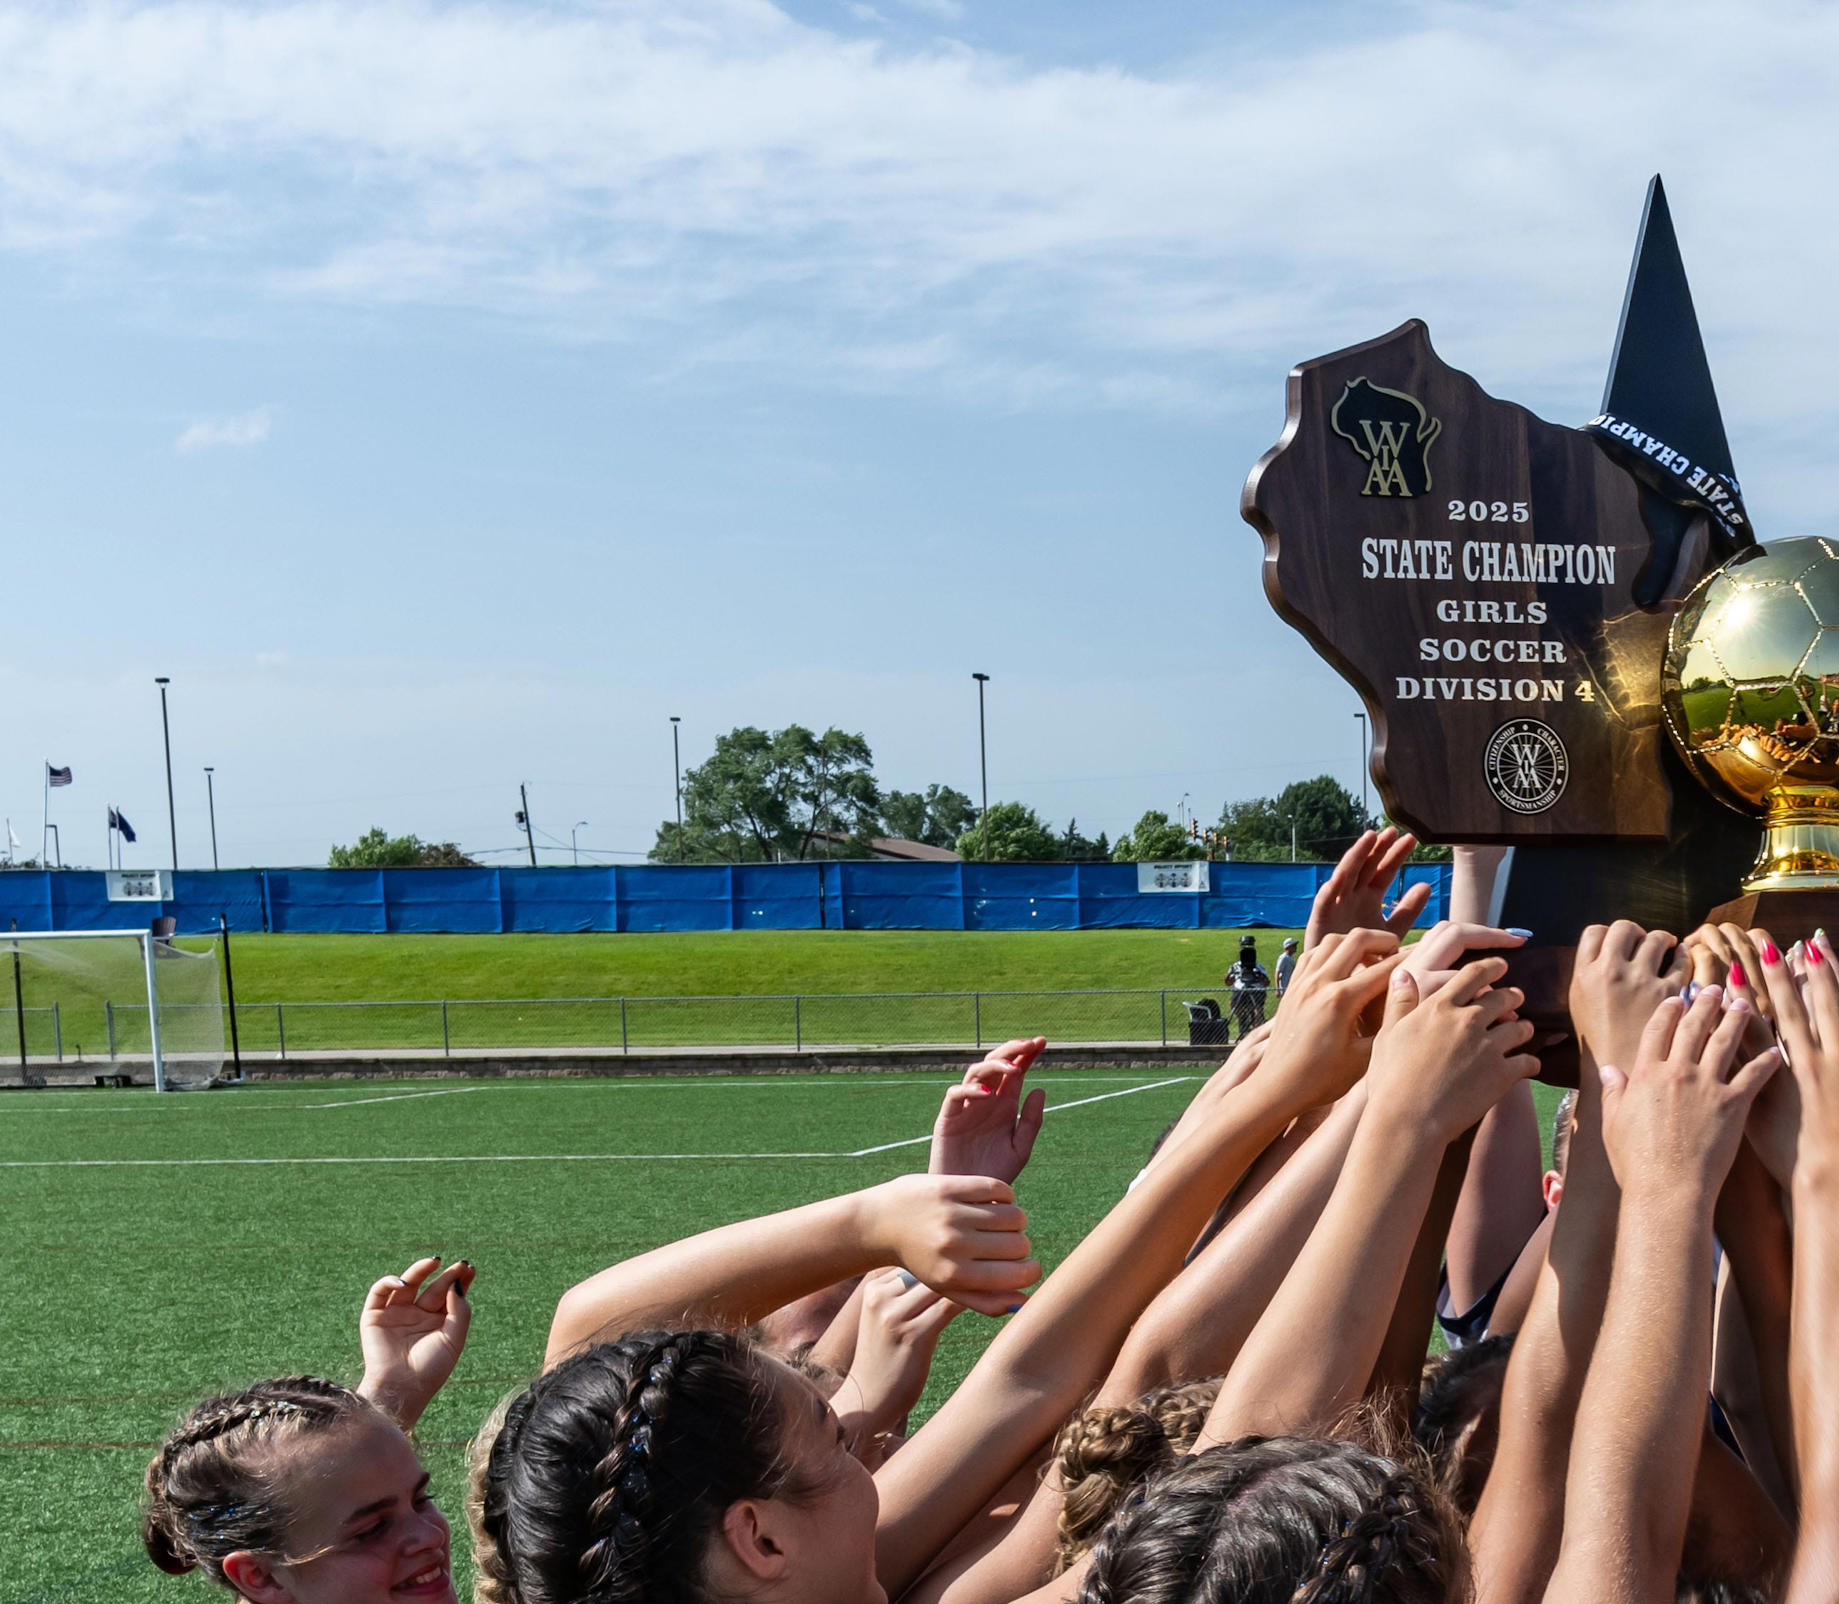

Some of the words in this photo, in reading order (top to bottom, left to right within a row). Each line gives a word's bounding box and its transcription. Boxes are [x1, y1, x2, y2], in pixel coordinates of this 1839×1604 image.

[1686, 466, 1744, 525] STATE
[1448, 500, 1529, 522] 2025
[1361, 537, 1453, 580] STATE
[1463, 541, 1616, 584] CHAMPION
[1436, 599, 1547, 625] GIRLS
[1419, 638, 1567, 664] SOCCER
[1396, 677, 1565, 702] DIVISION
[1575, 680, 1595, 702] 4
[1488, 727, 1516, 771] CITIZENSHIP
[1537, 728, 1565, 771] CHARACTER
[1499, 789, 1557, 810] SPORTSMANSHIP
